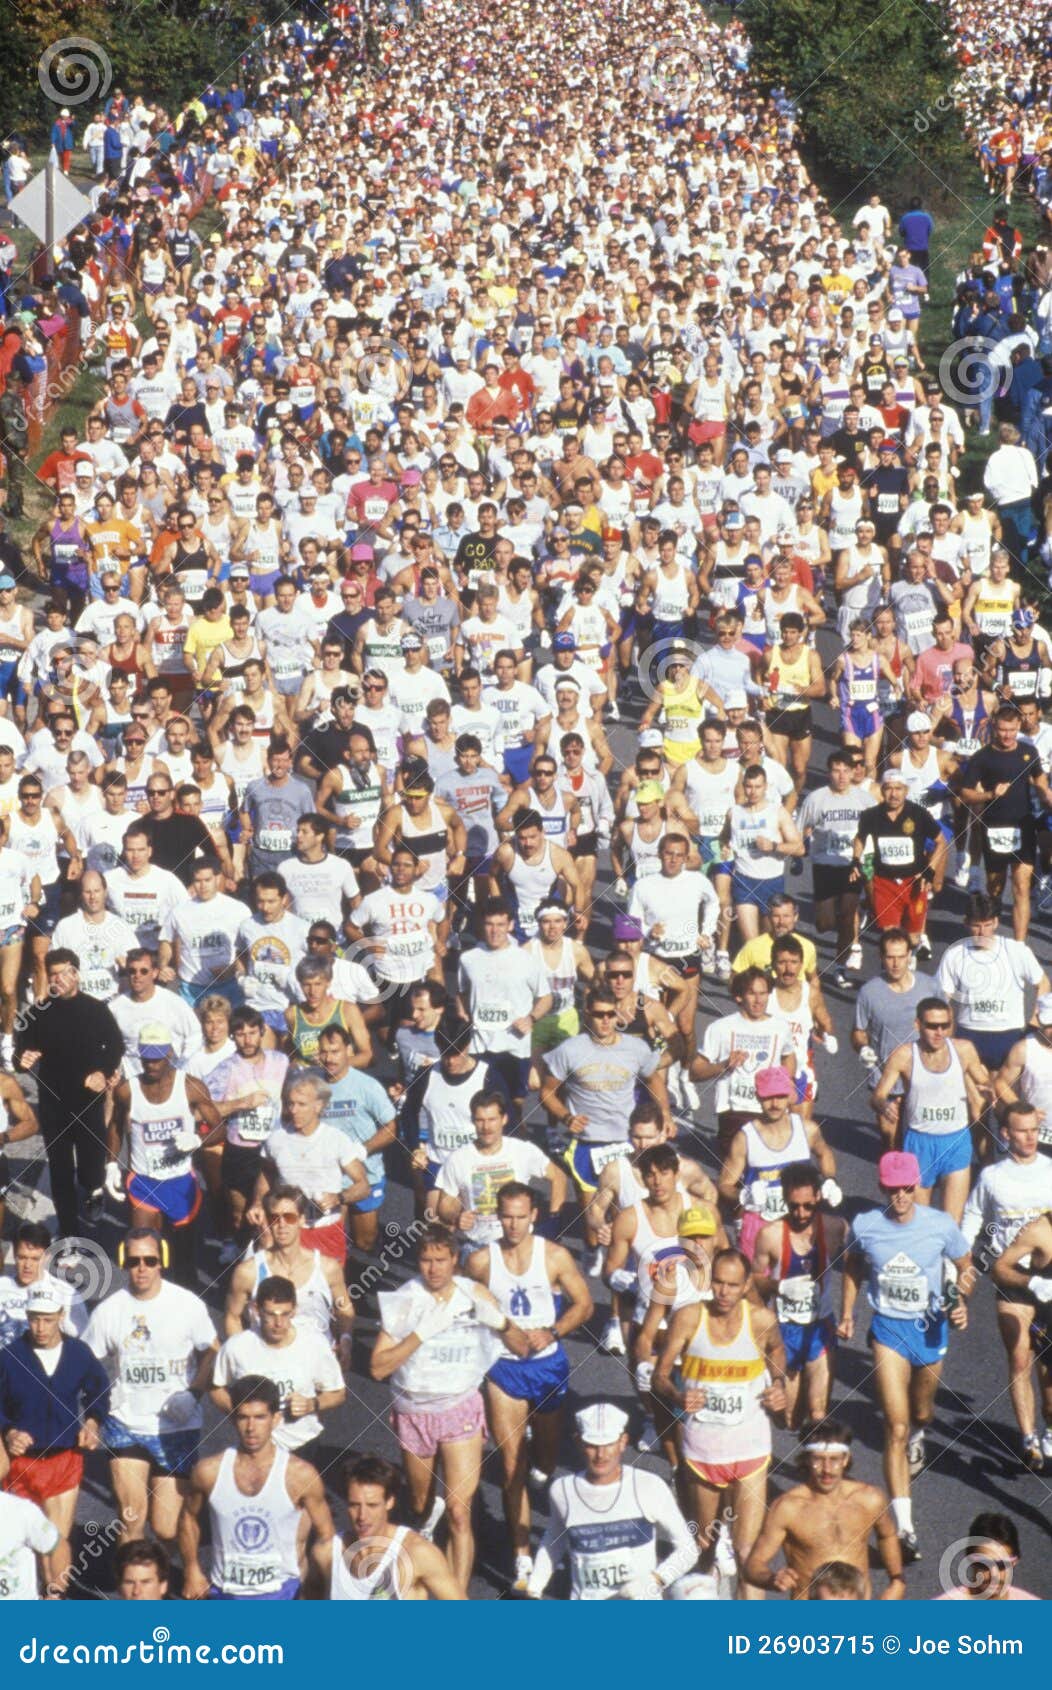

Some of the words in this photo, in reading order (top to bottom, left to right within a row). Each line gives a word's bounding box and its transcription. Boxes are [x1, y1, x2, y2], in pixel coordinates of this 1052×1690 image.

[465, 544, 485, 556] GO
[882, 845, 910, 857] A9361
[390, 902, 424, 918] HO
[922, 1106, 956, 1122] A1697
[147, 1118, 177, 1133] BUD
[887, 1287, 920, 1302] A426
[126, 1367, 166, 1385] A9075
[230, 1565, 275, 1586] A1205
